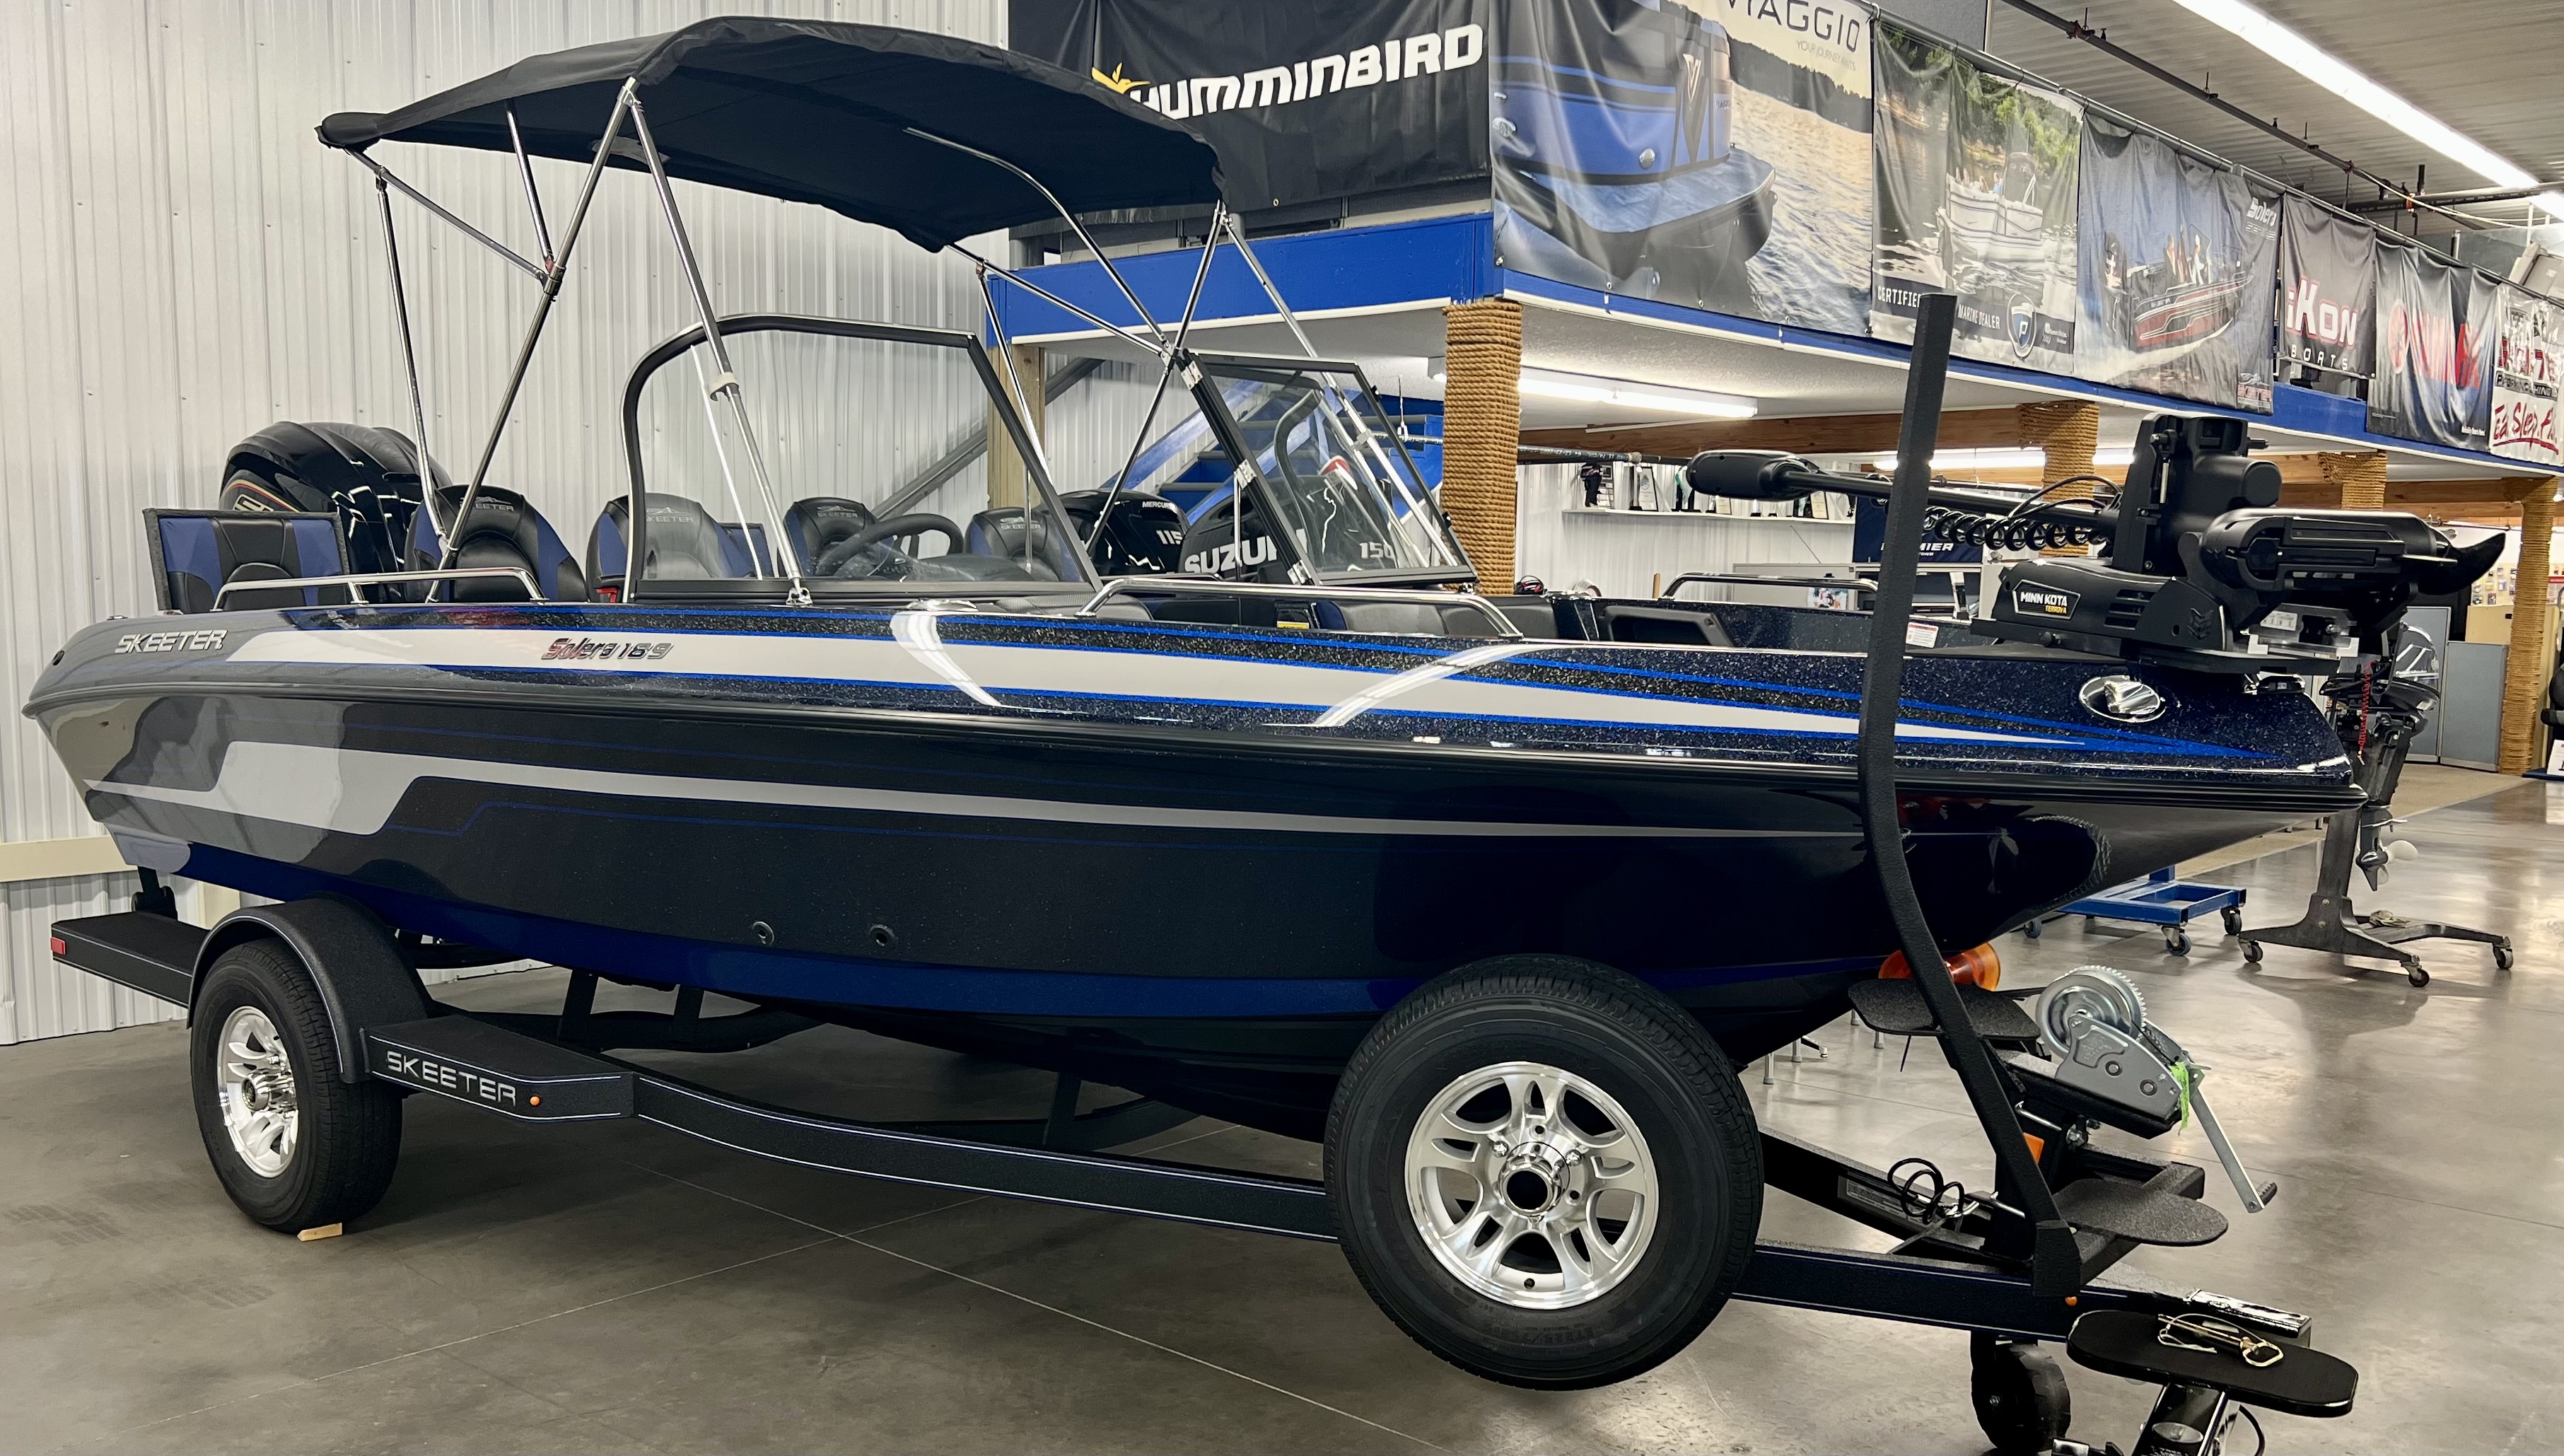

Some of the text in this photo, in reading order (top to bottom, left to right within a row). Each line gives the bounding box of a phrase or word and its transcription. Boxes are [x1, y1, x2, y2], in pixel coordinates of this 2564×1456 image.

[1726, 0, 1860, 52] IAGGIO
[1958, 304, 2000, 330] MARINE DEALER
[2291, 344, 2348, 371] BOATS
[459, 502, 514, 511] EETER
[1156, 530, 1183, 544] 115
[2020, 592, 2068, 606] MINN KOTA
[115, 629, 228, 654] SKEETER
[541, 638, 674, 660] Solera 189
[387, 1051, 516, 1107] SKEETER
